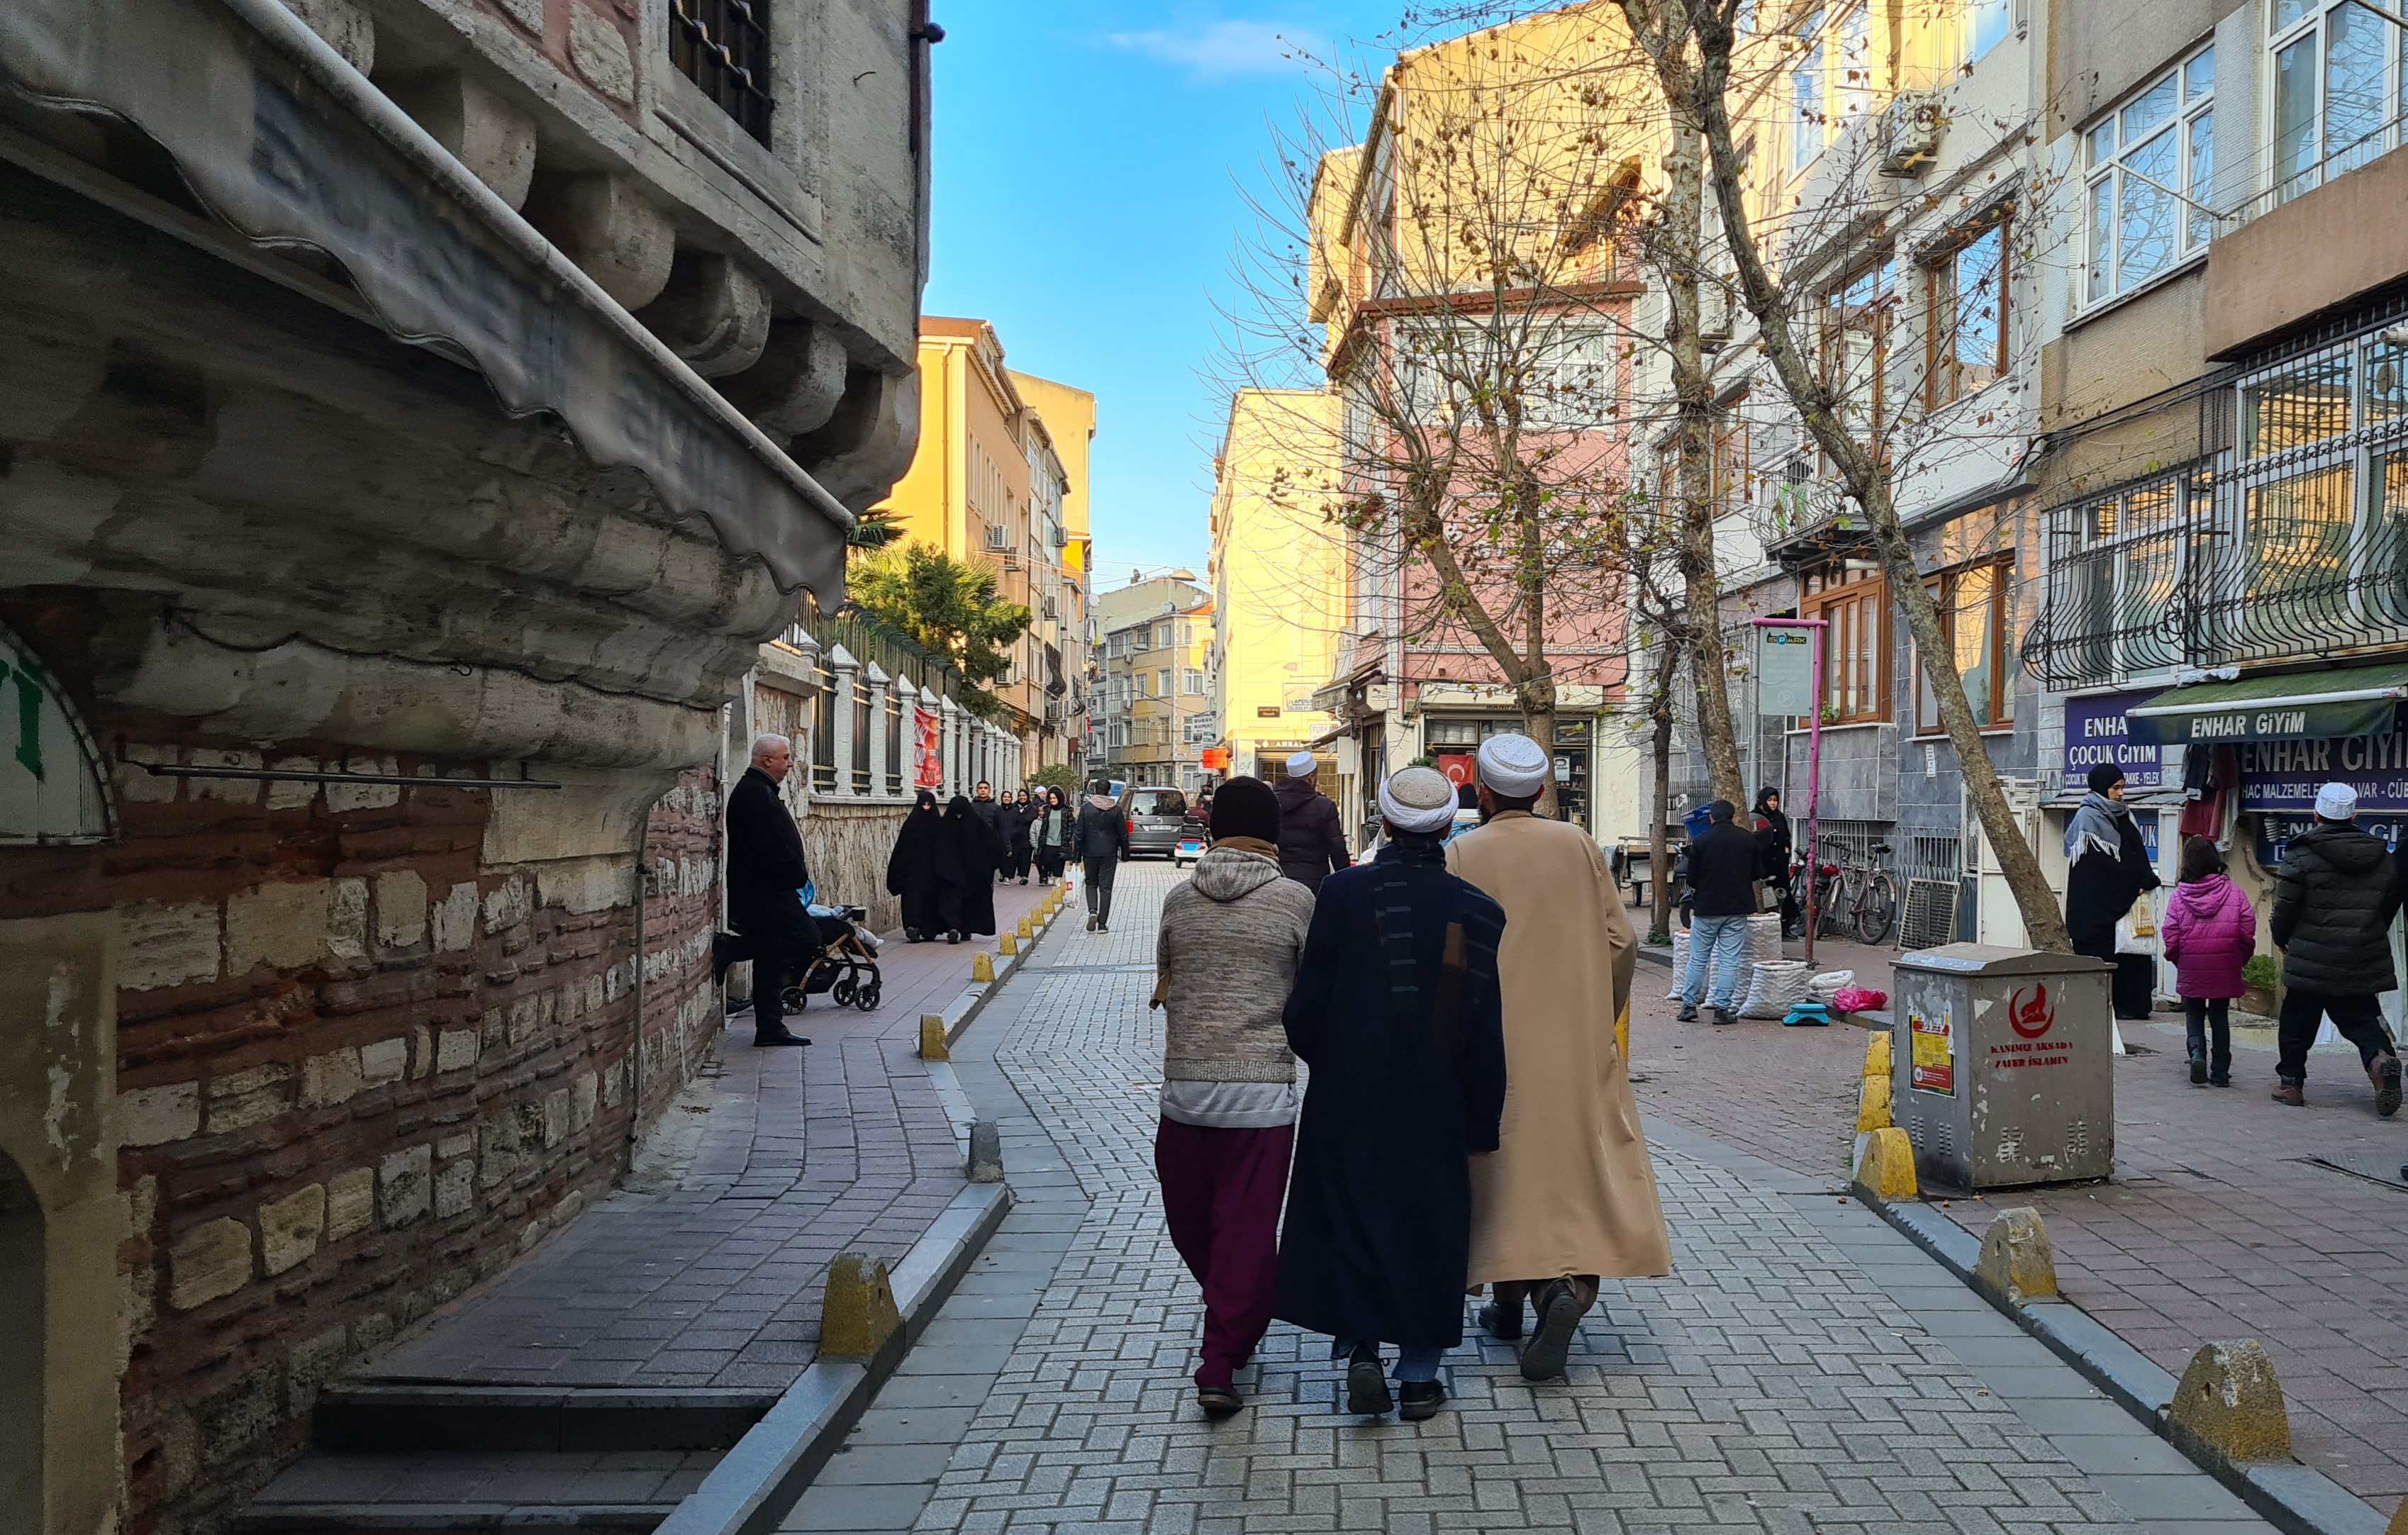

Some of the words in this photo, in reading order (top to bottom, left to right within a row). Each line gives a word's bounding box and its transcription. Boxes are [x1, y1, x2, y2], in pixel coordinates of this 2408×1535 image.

[2084, 716, 2128, 737] ENHA
[2191, 715, 2246, 738] ENHAR
[2069, 745, 2114, 770] ÇOCUK
[2241, 738, 2330, 772] ENHAR
[2066, 773, 2080, 787] ÇOCUK
[2144, 771, 2159, 785] YELEK
[2242, 783, 2261, 799] HAC
[2263, 781, 2329, 799] MALZEMELE
[1990, 1044, 2032, 1054] KANIMIZ
[1995, 1059, 2025, 1068] ZAFER
